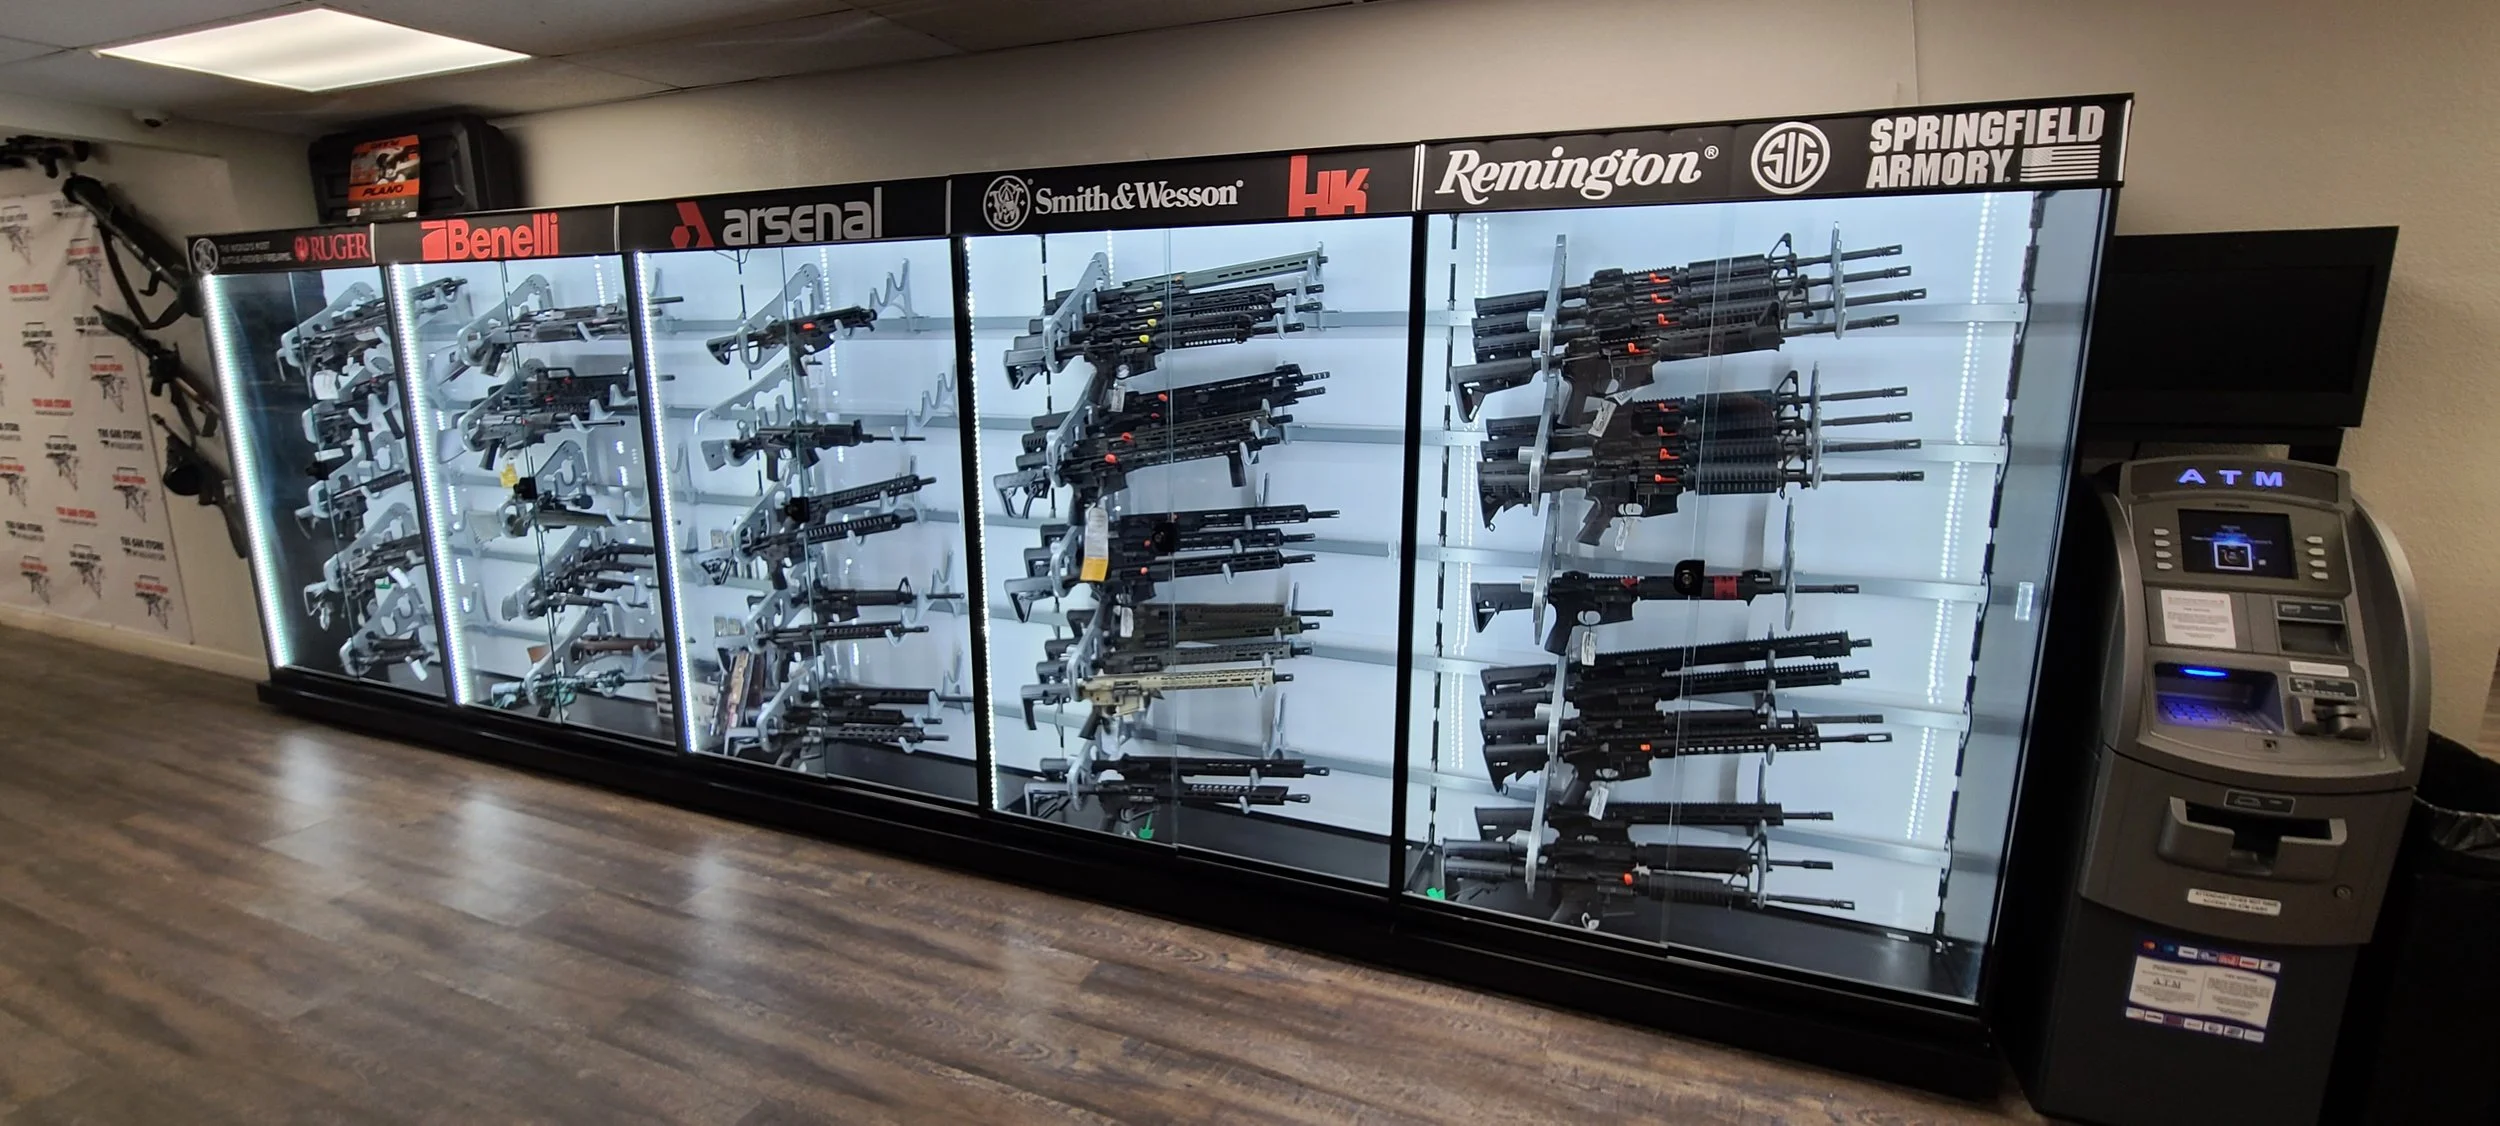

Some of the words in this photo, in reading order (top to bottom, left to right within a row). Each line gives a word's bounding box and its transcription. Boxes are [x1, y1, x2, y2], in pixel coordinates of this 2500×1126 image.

[1869, 105, 2105, 153] SPRINGFIELD
[1761, 131, 1820, 185] SIG
[362, 184, 404, 197] PLANO
[1287, 154, 1370, 217] HK
[447, 212, 559, 260] Benelli
[722, 186, 883, 246] arsenal
[310, 232, 371, 261] RUGER
[2178, 468, 2283, 487] ATM
